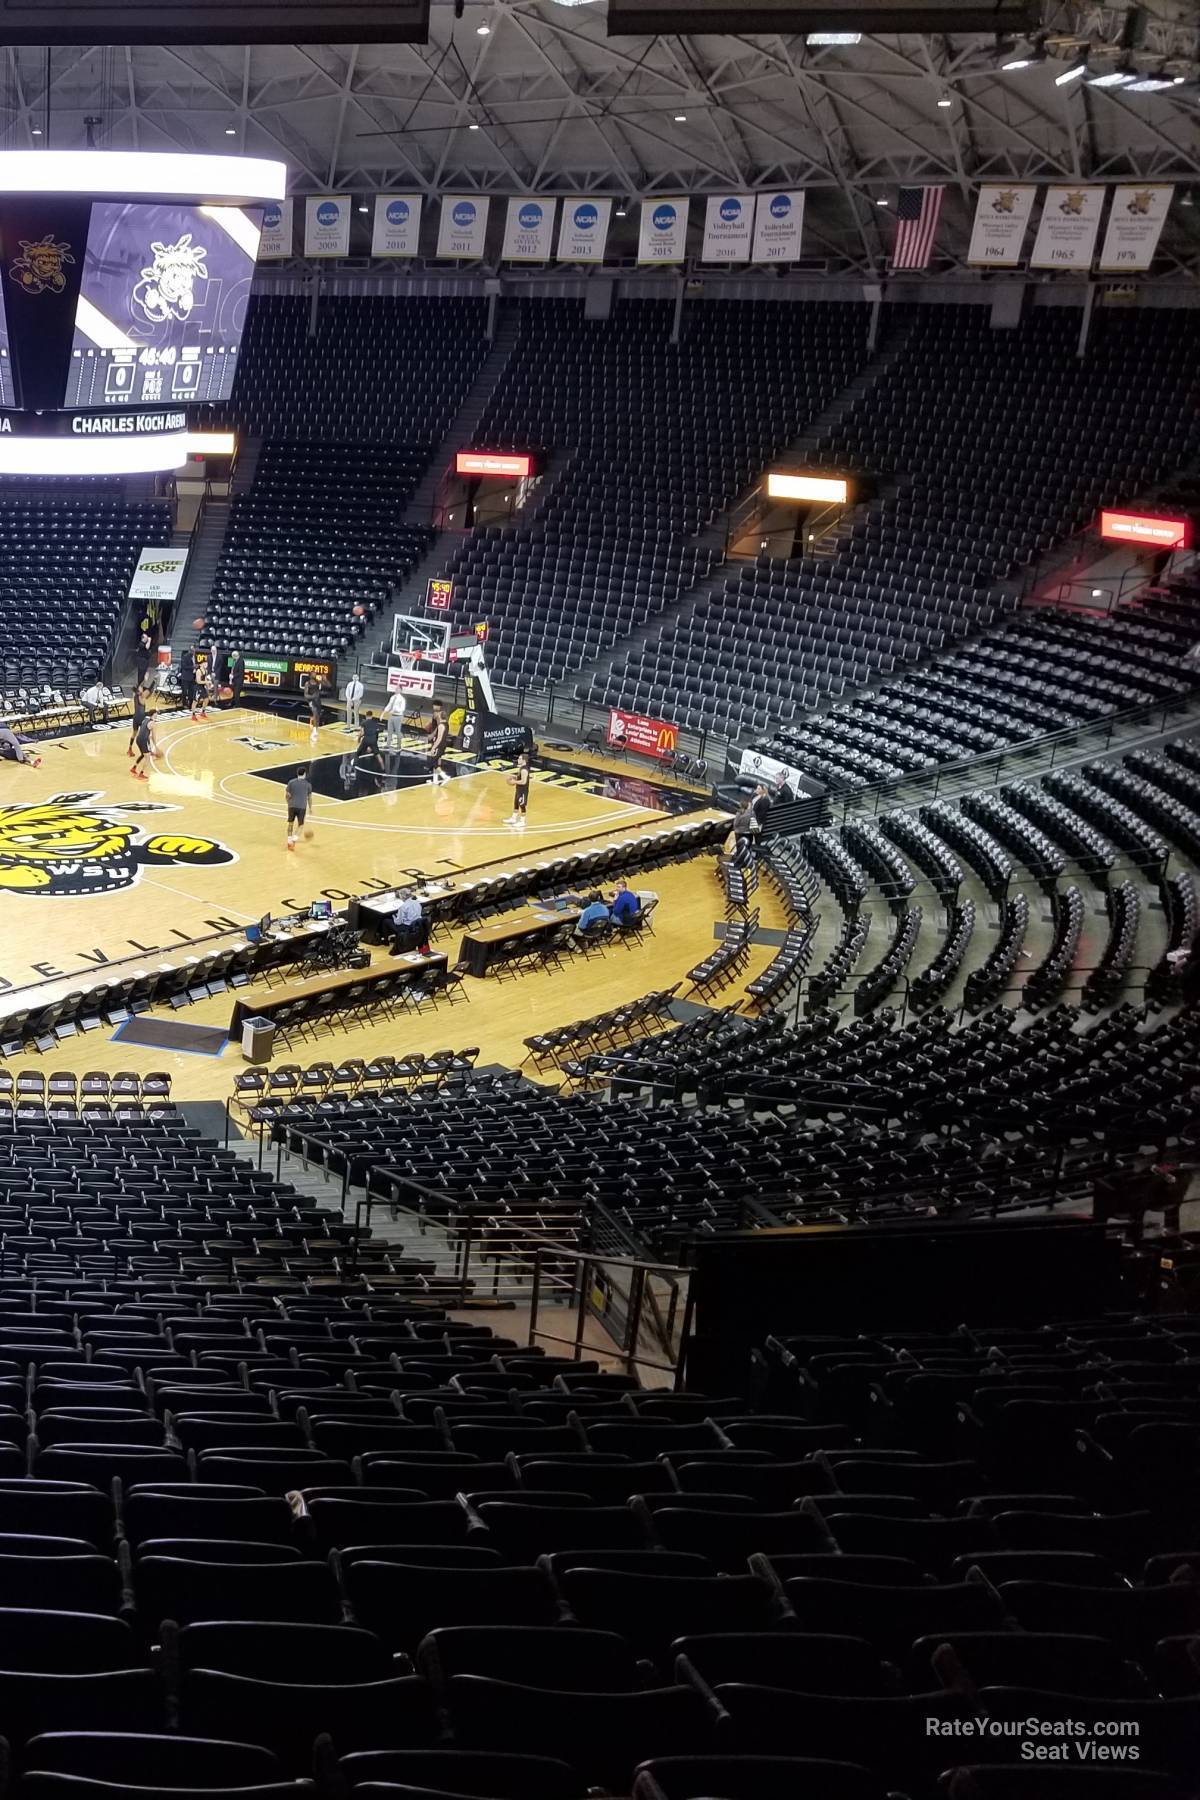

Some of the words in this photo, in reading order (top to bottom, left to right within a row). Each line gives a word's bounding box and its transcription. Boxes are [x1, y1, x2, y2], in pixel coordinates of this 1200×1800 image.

[721, 208, 741, 216] NCAA
[772, 205, 791, 213] NCAA
[319, 213, 339, 221] NCAA
[388, 212, 409, 220] NCAA
[455, 213, 476, 221] NCAA
[655, 216, 676, 224] NCAA
[712, 223, 745, 231] Volleyball
[764, 223, 794, 231] Volleyball
[708, 232, 748, 240] Tournament
[318, 242, 337, 250] 2009
[386, 241, 406, 249] 2010
[451, 243, 471, 251] 2011
[572, 246, 592, 255] 2013
[652, 247, 673, 256] 2015
[766, 247, 786, 257] 2017
[985, 247, 1005, 256] 1964
[1051, 249, 1075, 259] 1965
[116, 368, 126, 386] 0
[183, 365, 192, 384] 0
[73, 416, 134, 433] CHARLES
[136, 415, 164, 431] KOCH
[431, 582, 450, 593] 45:40
[432, 592, 446, 606] 23
[389, 673, 433, 691] ESPN
[464, 676, 475, 710] WSU
[484, 730, 504, 738] KANSAS
[46, 864, 129, 879] WSU
[281, 858, 464, 911] COURT
